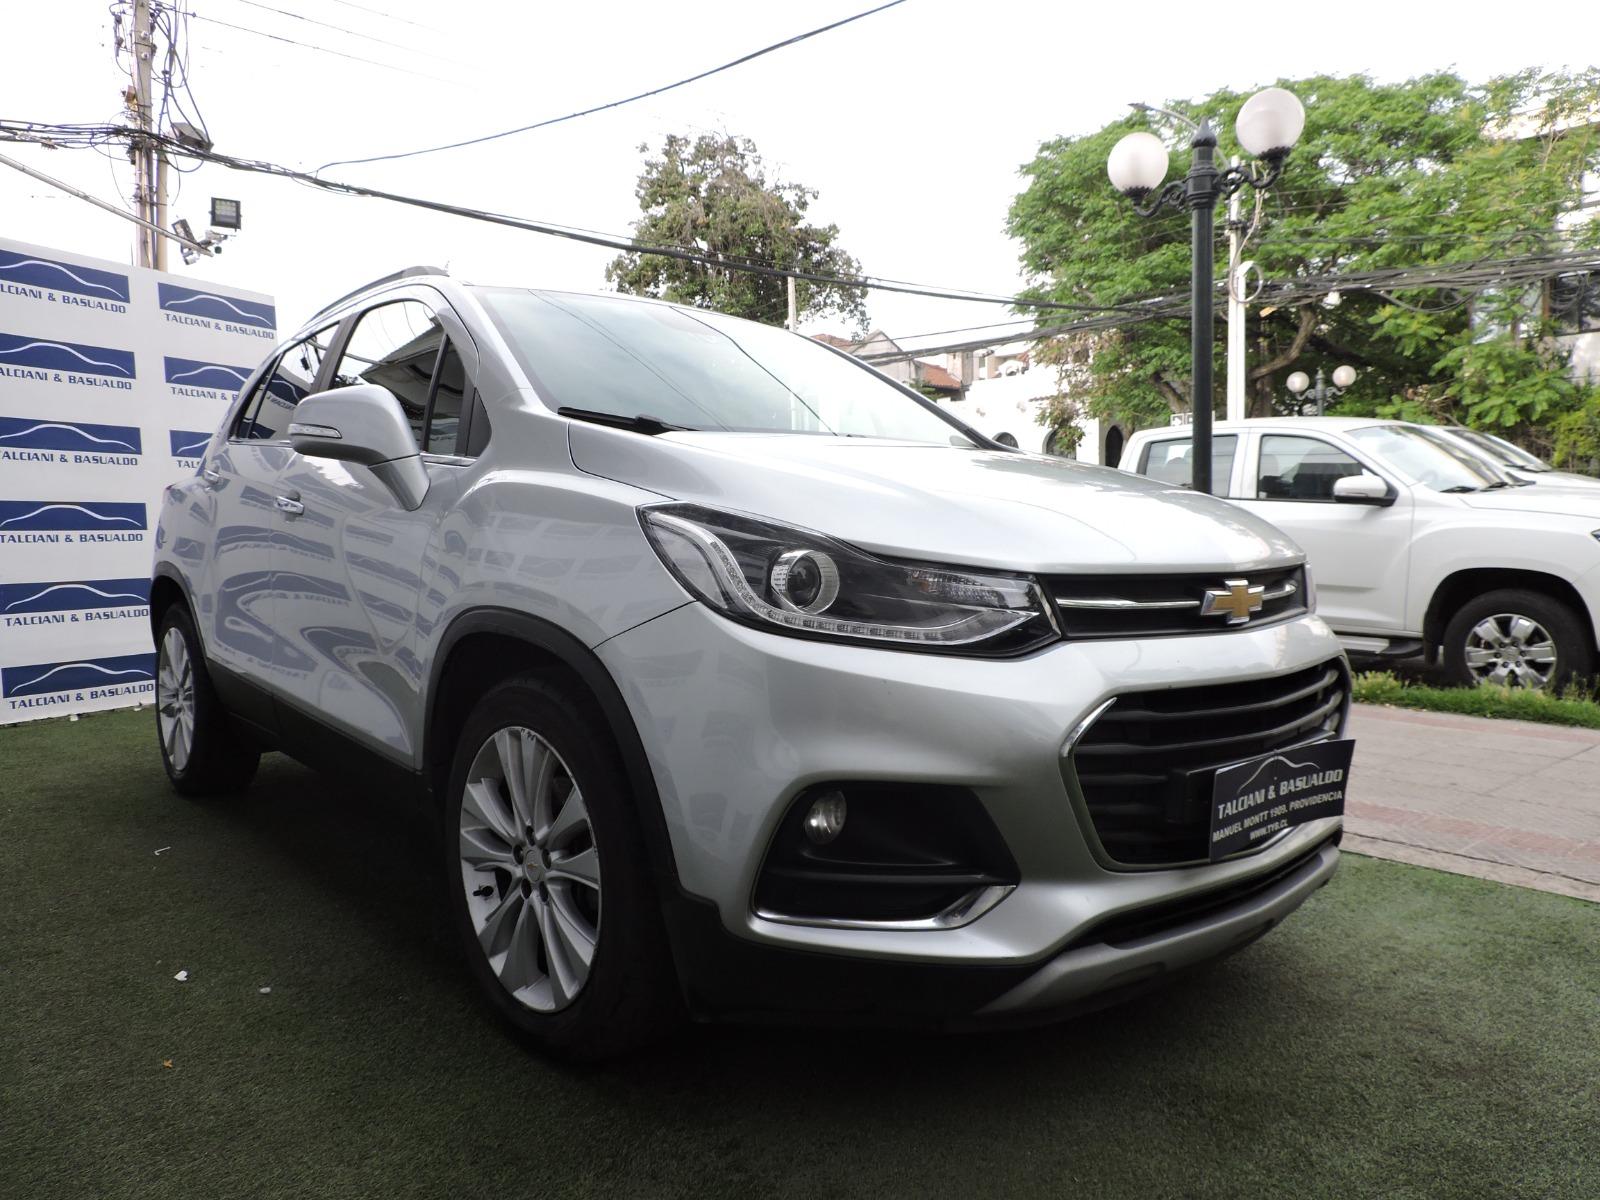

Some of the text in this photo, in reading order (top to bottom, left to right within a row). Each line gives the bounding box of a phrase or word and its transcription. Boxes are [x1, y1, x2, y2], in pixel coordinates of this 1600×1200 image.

[0, 283, 126, 313] LCIANI & BASUALDO
[166, 312, 274, 339] TALCIANI & BASUALDO
[0, 367, 132, 389] ALCIANI & BASUALDO
[170, 386, 217, 399] TALCIANI
[221, 392, 228, 400] &
[0, 450, 138, 465] ALCIANI & BASUALDO
[0, 533, 143, 543] TALCIANI & BASUALDO
[5, 608, 149, 627] TALCIANI & BASUALDO
[9, 683, 154, 709] TALCIANI & BASUALDO
[1218, 769, 1343, 820] TALCIANI & BASUALDO
[1212, 821, 1243, 843] MANUEL
[1243, 810, 1269, 830] MONTT
[1289, 790, 1343, 814] PROVIDENCIA
